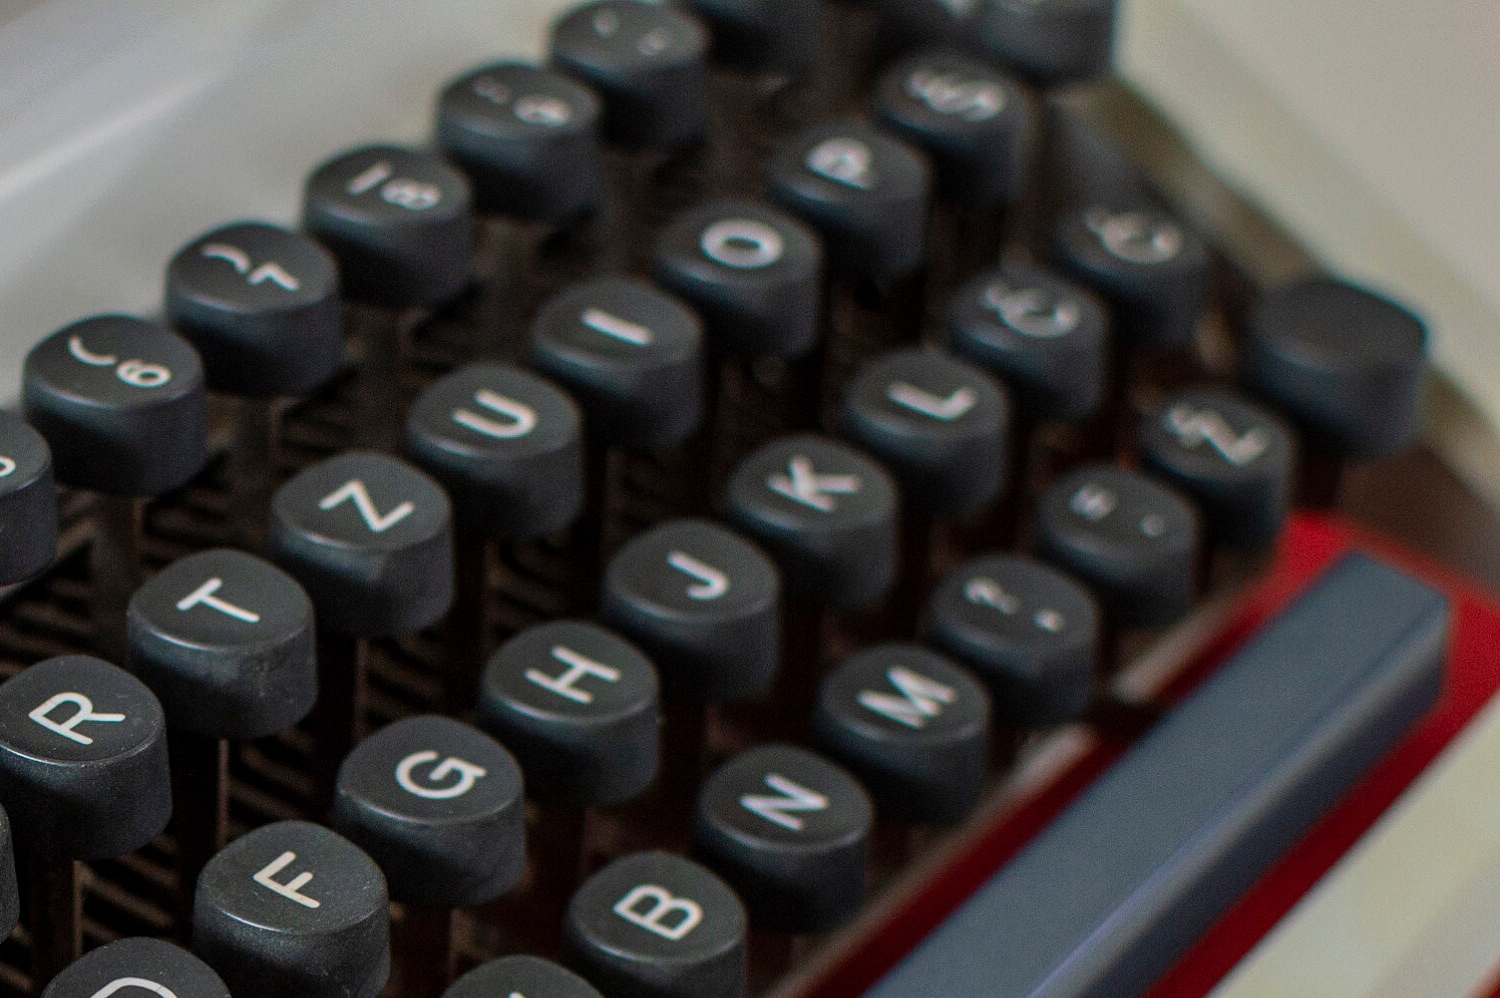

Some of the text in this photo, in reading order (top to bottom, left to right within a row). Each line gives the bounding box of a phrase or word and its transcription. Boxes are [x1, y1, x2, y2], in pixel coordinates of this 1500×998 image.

[382, 181, 441, 210] 8
[701, 220, 784, 268] O
[248, 262, 300, 292] 7
[582, 309, 652, 346] I
[115, 359, 172, 389] 6
[453, 389, 538, 439] U
[890, 384, 976, 420] L
[319, 479, 415, 533] Z
[770, 458, 860, 512] K
[175, 577, 261, 624] T
[668, 552, 730, 601] J
[525, 646, 621, 705] H
[859, 667, 955, 728] M
[27, 690, 127, 746] R
[394, 749, 487, 800] G
[740, 774, 830, 832] N
[252, 850, 322, 910] F
[613, 884, 704, 942] B
